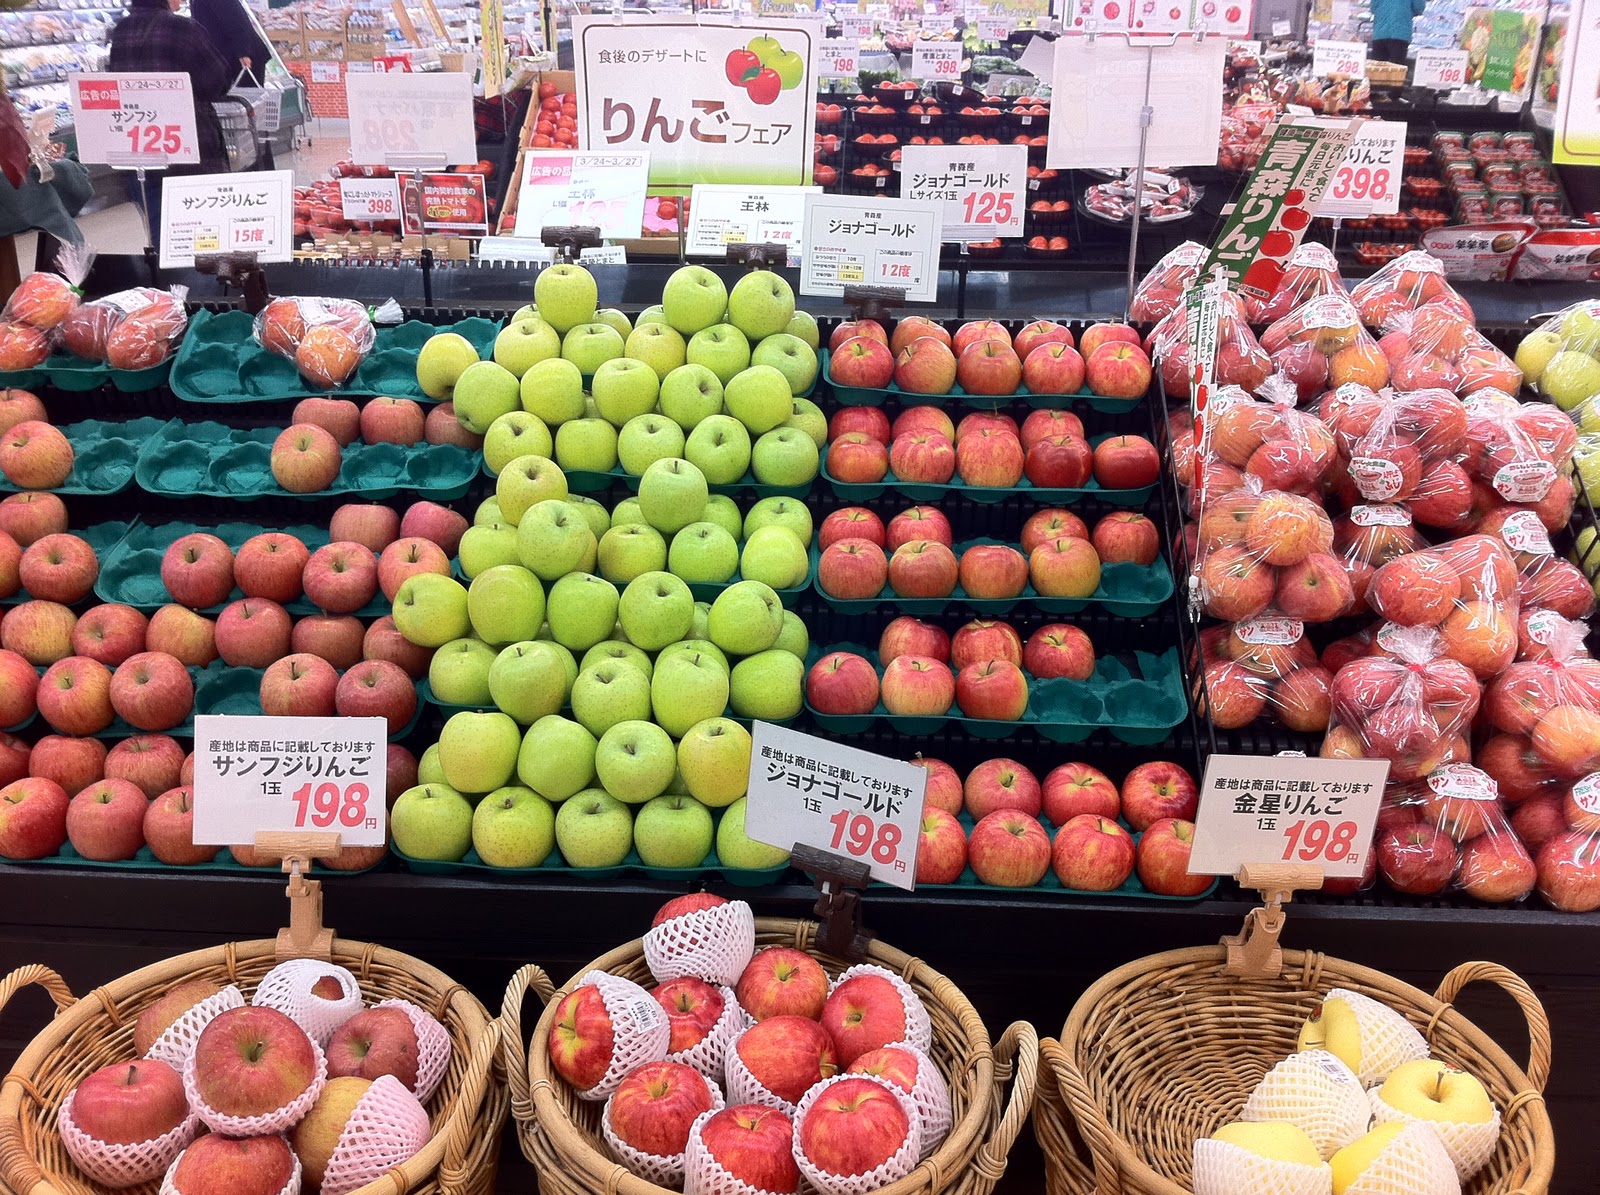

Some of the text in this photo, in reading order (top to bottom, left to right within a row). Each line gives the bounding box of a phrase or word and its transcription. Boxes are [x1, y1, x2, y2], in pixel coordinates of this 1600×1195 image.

[598, 49, 707, 64] 食後のデザートに
[81, 89, 119, 101] 広告の品
[112, 110, 157, 123] サンフジ
[603, 97, 793, 145] りんごフェア
[531, 165, 571, 176] 広告の品
[949, 163, 976, 172] 青森産
[1300, 141, 1333, 187] 毎日元気に
[1309, 143, 1345, 202] おいしく食べて
[913, 173, 1010, 189] ジョナゴールド
[182, 193, 268, 210] サンフジりんご
[426, 197, 467, 206] 完熟トマトを
[910, 190, 958, 200] Lサイズ1玉
[740, 201, 769, 212] 王林
[829, 219, 916, 238] ジョナゴールド
[882, 263, 911, 277] 12度
[1385, 480, 1400, 490] ふじ
[1497, 483, 1512, 494] サン
[1355, 512, 1369, 523] サン
[1509, 535, 1525, 546] サン
[1240, 626, 1254, 638] サン
[1288, 625, 1300, 638] ふじ
[1535, 630, 1551, 641] サン
[209, 739, 376, 753] 産地は商品に記載しております
[212, 755, 371, 778] サンフジりんご
[760, 745, 913, 799] 産地は商品に記載しております
[260, 781, 282, 795] 1玉
[766, 762, 903, 818] ジョナゴールド
[1214, 777, 1373, 794] 産地は商品に記載しております
[1432, 777, 1449, 789] サン
[803, 796, 822, 814] 1玉
[1232, 792, 1348, 816] 金星りんご
[1580, 794, 1597, 808] サン
[1256, 817, 1278, 830] 1玉
